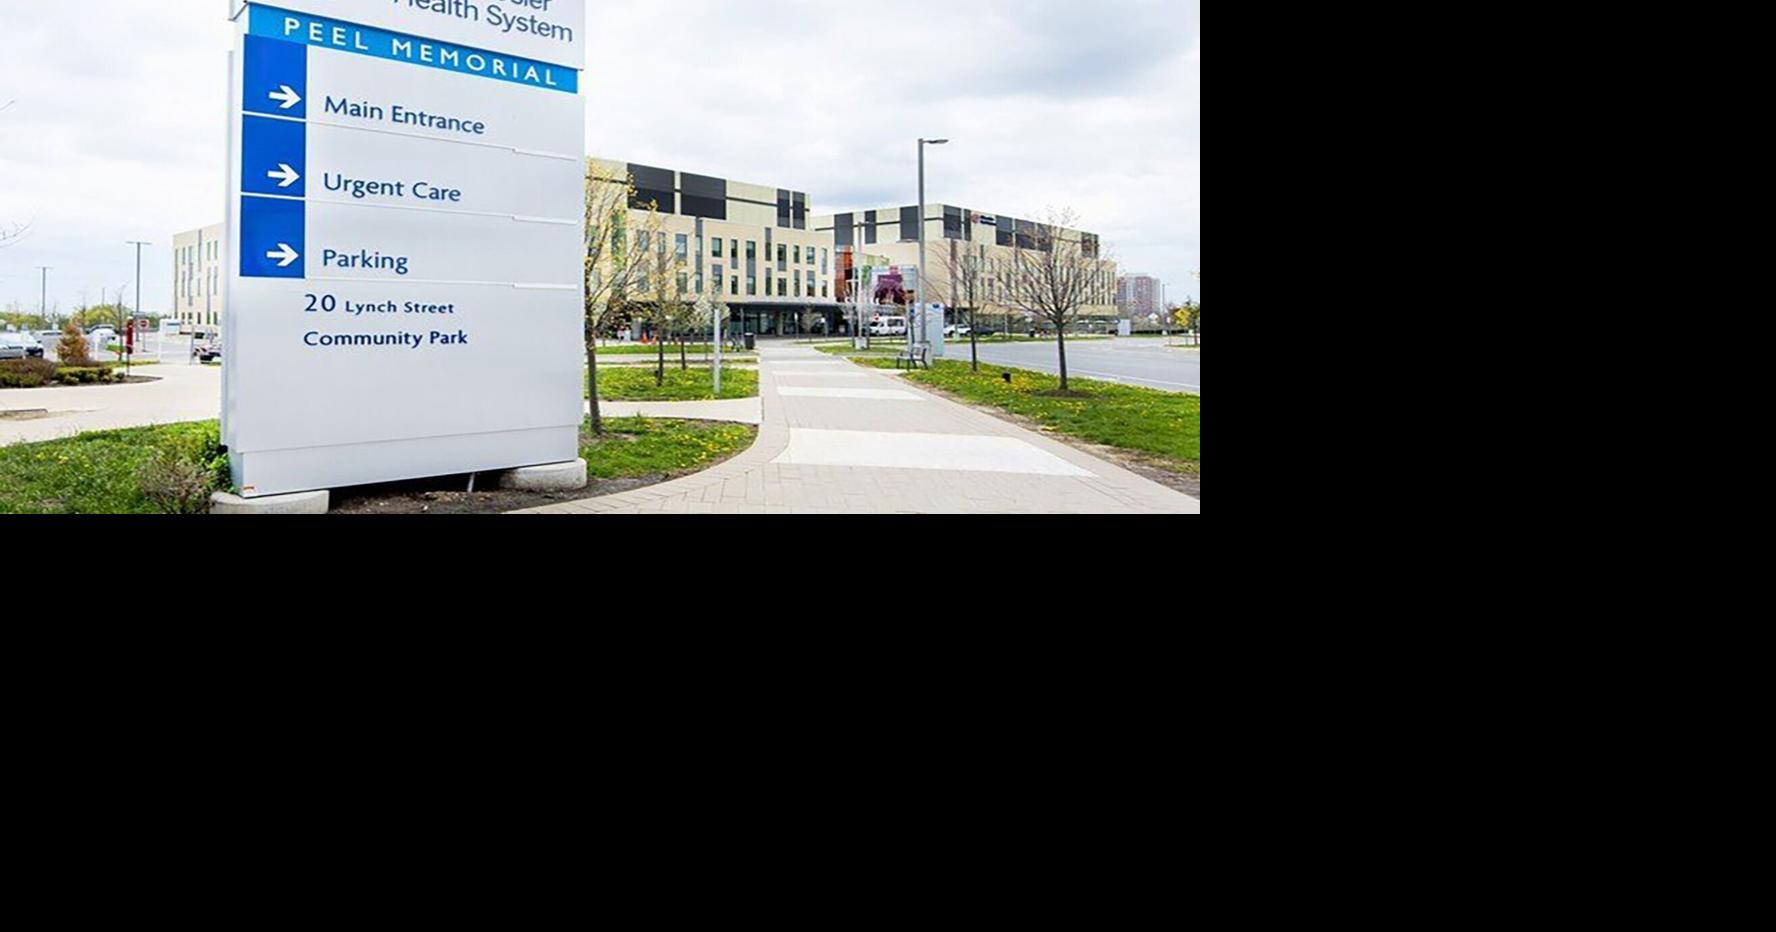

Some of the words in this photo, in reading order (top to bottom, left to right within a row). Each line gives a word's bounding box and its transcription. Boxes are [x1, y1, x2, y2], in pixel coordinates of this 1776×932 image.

[394, 0, 479, 21] ealth
[486, 4, 573, 42] System
[284, 17, 369, 50] PEEL
[392, 39, 557, 86] MEMORIAL
[324, 95, 383, 120] Main
[391, 105, 485, 135] Entrance
[323, 172, 405, 199] Urgent
[412, 181, 461, 202] Care
[322, 249, 409, 275] Parking
[304, 293, 336, 313] 20
[345, 300, 397, 315] Lynch
[403, 300, 454, 314] Street
[303, 330, 423, 349] Community
[429, 329, 468, 345] Park
